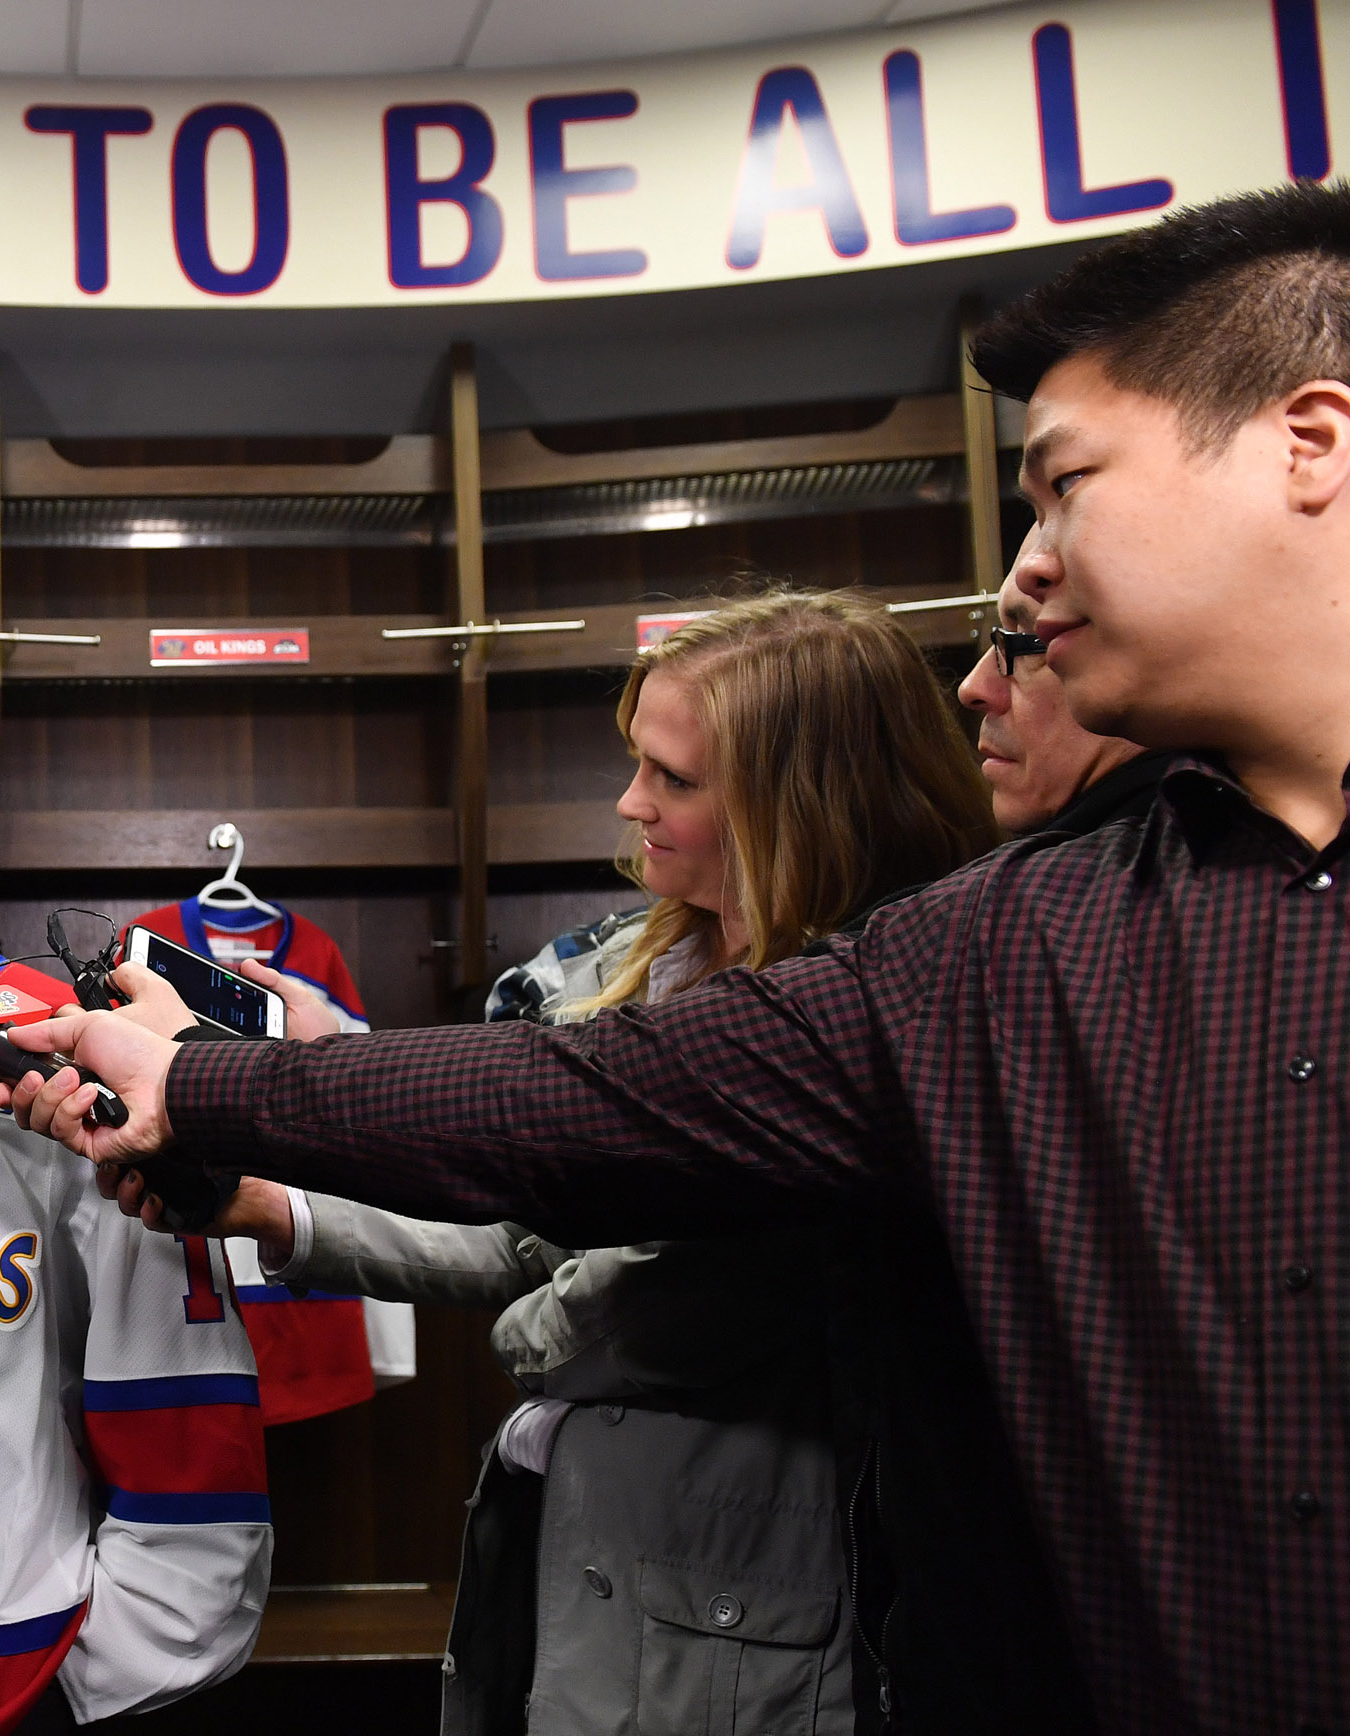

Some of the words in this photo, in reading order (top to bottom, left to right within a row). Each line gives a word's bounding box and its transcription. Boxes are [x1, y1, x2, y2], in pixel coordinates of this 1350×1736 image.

[23, 102, 290, 297] TO
[381, 88, 649, 290] BE
[725, 21, 1175, 271] ALL
[193, 640, 219, 655] OIL
[219, 640, 267, 655] KINGS
